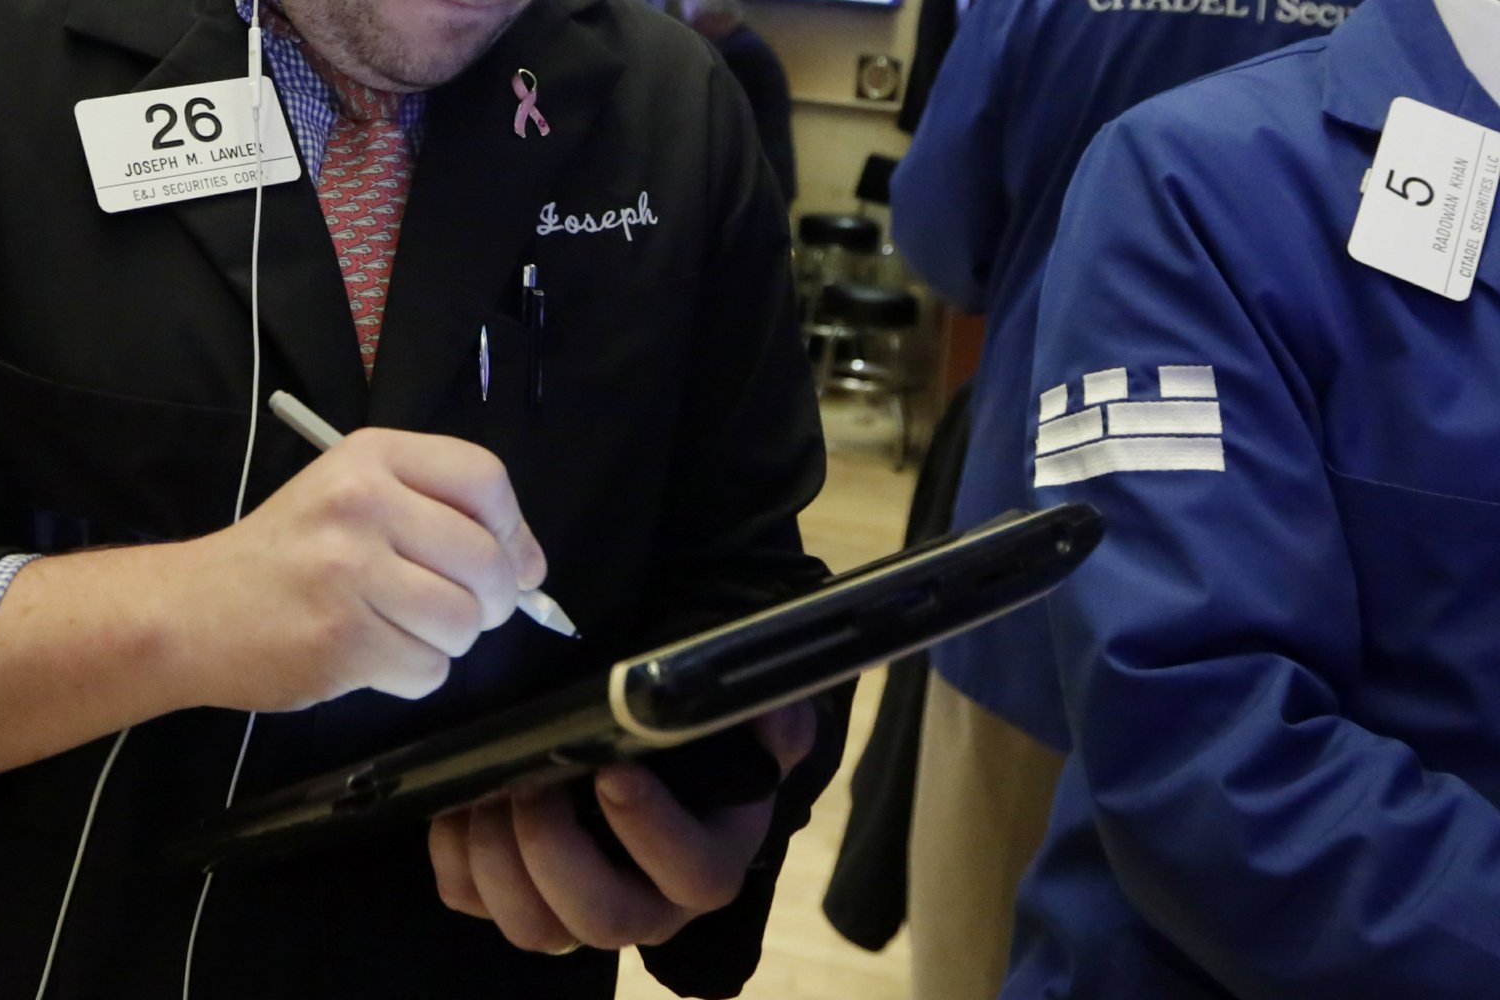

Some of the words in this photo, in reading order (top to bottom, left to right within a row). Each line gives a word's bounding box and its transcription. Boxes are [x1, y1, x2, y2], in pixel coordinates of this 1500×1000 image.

[145, 97, 223, 150] 26
[125, 156, 178, 177] JOSEPH
[186, 153, 203, 169] M.
[133, 186, 156, 201] E&J
[162, 174, 229, 197] SECURITIES
[1385, 169, 1435, 207] 5
[536, 191, 658, 242] Joseph
[1432, 194, 1459, 253] RADOWAN
[1449, 157, 1469, 190] KHAN
[1459, 238, 1480, 279] CITADEL
[1470, 178, 1493, 233] SECURITIES
[1486, 155, 1500, 175] LLC
